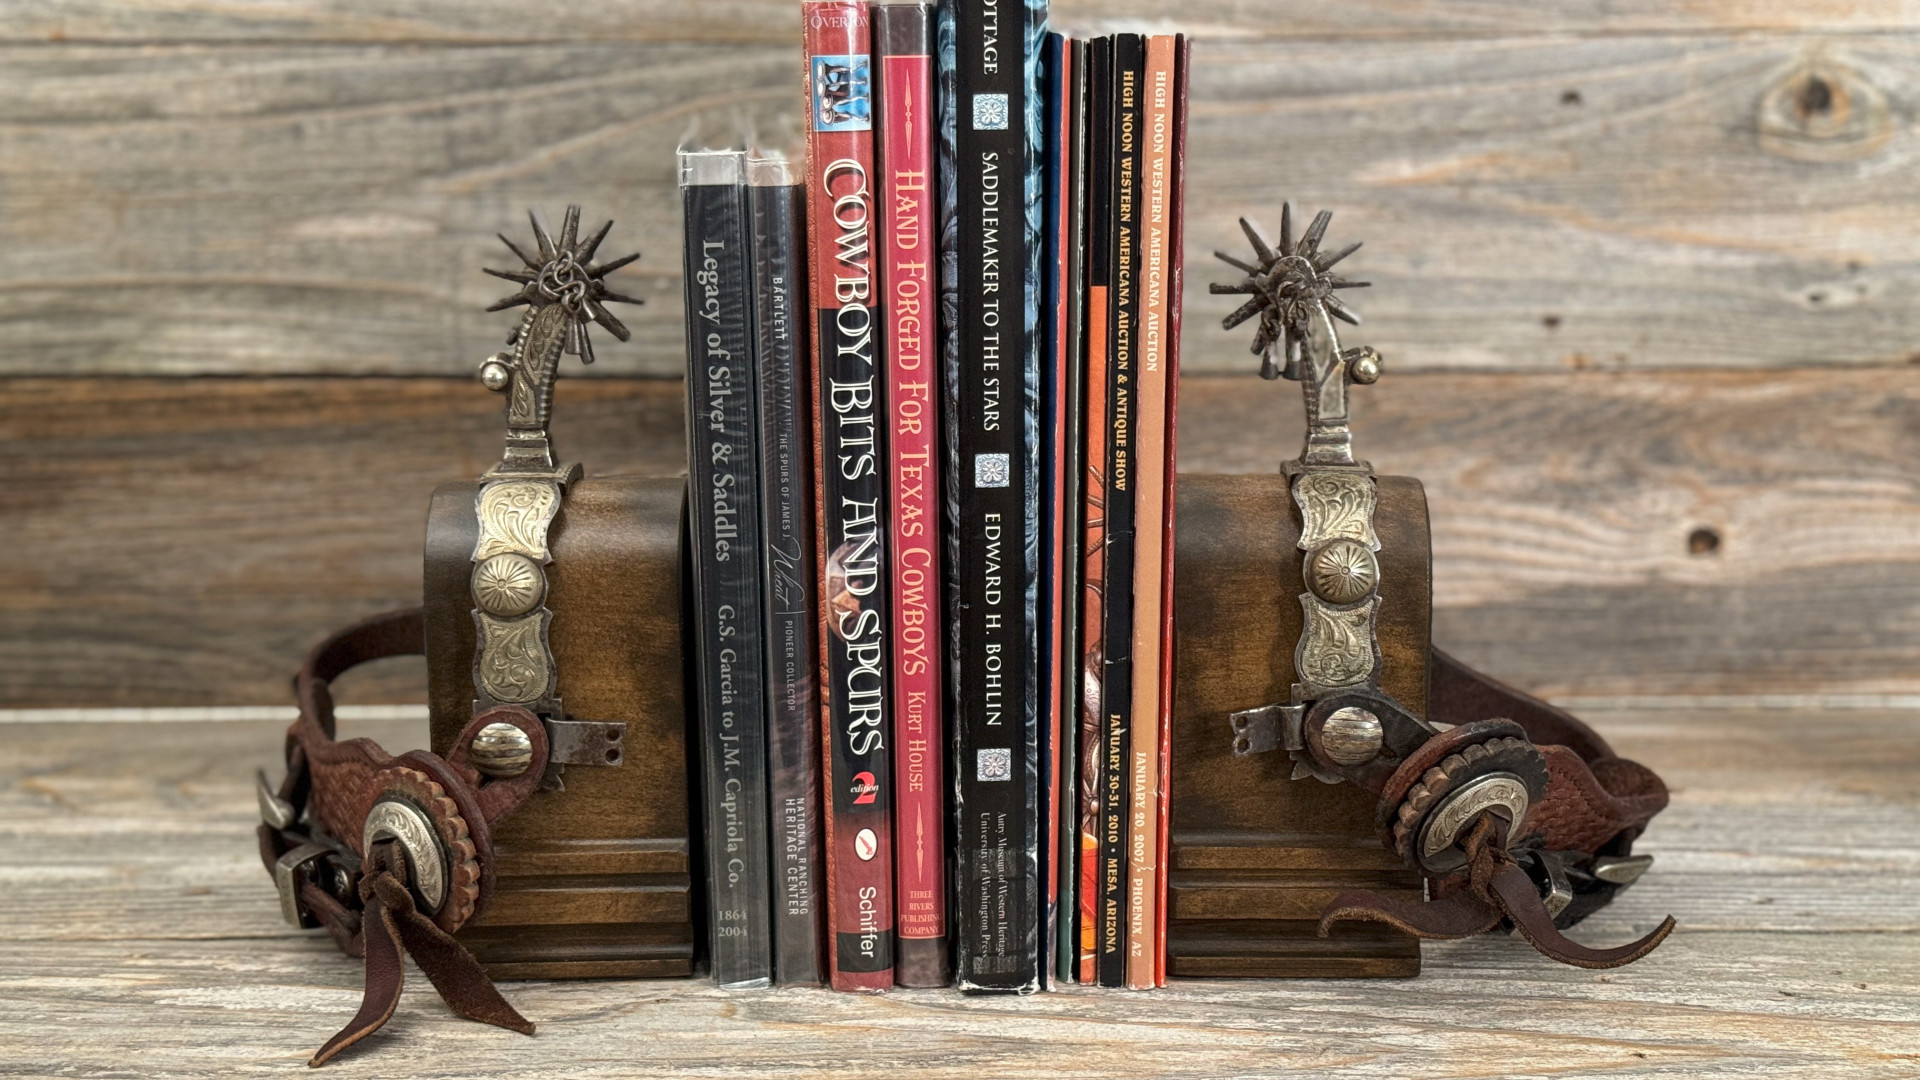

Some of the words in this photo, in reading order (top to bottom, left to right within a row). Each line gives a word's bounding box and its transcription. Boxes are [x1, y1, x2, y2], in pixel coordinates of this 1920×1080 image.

[811, 15, 868, 29] OVERON
[1122, 70, 1135, 108] HIGH
[1154, 71, 1167, 108] HIGH
[1121, 112, 1133, 152] NOON
[1152, 113, 1166, 153] NOON
[895, 169, 926, 250] HAND
[1120, 157, 1133, 222] WESTERN
[1151, 157, 1164, 223] WESTERN
[982, 152, 999, 296] SADDLEMAKER
[824, 159, 873, 365] COWBOY
[1118, 226, 1131, 306] AMERICANA
[1148, 227, 1162, 308] AMERICANA
[697, 240, 724, 325] Legacy
[773, 277, 784, 341] BARTLETT
[896, 260, 927, 371] FORGED
[983, 300, 1000, 327] TO
[707, 333, 731, 360] of
[983, 332, 1000, 371] THE
[1117, 310, 1129, 370] AUCTION
[1146, 311, 1159, 371] AUCTION
[708, 366, 732, 433] Silver
[1117, 374, 1128, 385] &
[898, 380, 929, 435] FOR
[983, 377, 1000, 431] STARS
[1114, 388, 1127, 447] ANTIQUE
[779, 433, 788, 449] THE
[829, 375, 877, 480] BITS
[712, 442, 732, 465] &
[780, 453, 789, 483] SPURS
[1115, 450, 1126, 491] SHOW
[781, 487, 790, 498] OF
[900, 444, 929, 537] TEXAS
[713, 473, 737, 562] Saddles
[782, 500, 791, 530] JAMES
[782, 533, 791, 541] J.
[841, 495, 878, 596] AND
[771, 536, 805, 611] Wheat
[985, 513, 1001, 605] EDWARD
[718, 604, 735, 642] G.S.
[902, 547, 931, 676] COWBOYS
[985, 614, 1001, 635] H.
[784, 620, 794, 658] PIONEER
[720, 648, 738, 705] Garcia
[786, 662, 796, 711] COLLECTOR
[834, 609, 886, 756] SPURS
[985, 643, 1002, 726] BOHLIN
[722, 711, 735, 729] to
[907, 691, 926, 734] KURT
[720, 733, 741, 772] J.M.
[1109, 713, 1121, 771] JANUARY
[909, 739, 928, 792] HOUSE
[1135, 752, 1147, 808] JANUARY
[850, 784, 879, 793] edition
[852, 771, 876, 804] 2
[1108, 775, 1119, 811] 30-31,
[720, 778, 743, 852] Capriola
[785, 799, 797, 860] HERITAGE
[796, 798, 806, 852] NATIONAL
[995, 811, 1007, 834] Autry
[1108, 815, 1119, 843] 2010
[1133, 812, 1145, 830] 20,
[978, 812, 990, 860] University
[997, 837, 1007, 873] Museum
[728, 858, 745, 888] Co.
[798, 857, 808, 915] RANCHING
[981, 864, 990, 873] of
[997, 875, 1007, 886] of
[1107, 858, 1118, 895] MESA,
[788, 868, 799, 916] CENTER
[909, 902, 934, 911] RIVERS
[910, 890, 933, 899] THREE
[980, 877, 991, 930] Washington
[998, 886, 1008, 919] Western
[717, 910, 748, 920] 1864
[718, 926, 748, 937] 2004
[859, 887, 878, 957] Schiffer
[900, 913, 942, 922] PUBLISHING
[903, 926, 939, 935] COMPANY
[1106, 899, 1117, 954] ARIZONA
[982, 934, 991, 958] Press
[997, 921, 1008, 957] Heritage
[1131, 941, 1142, 957] AZ
